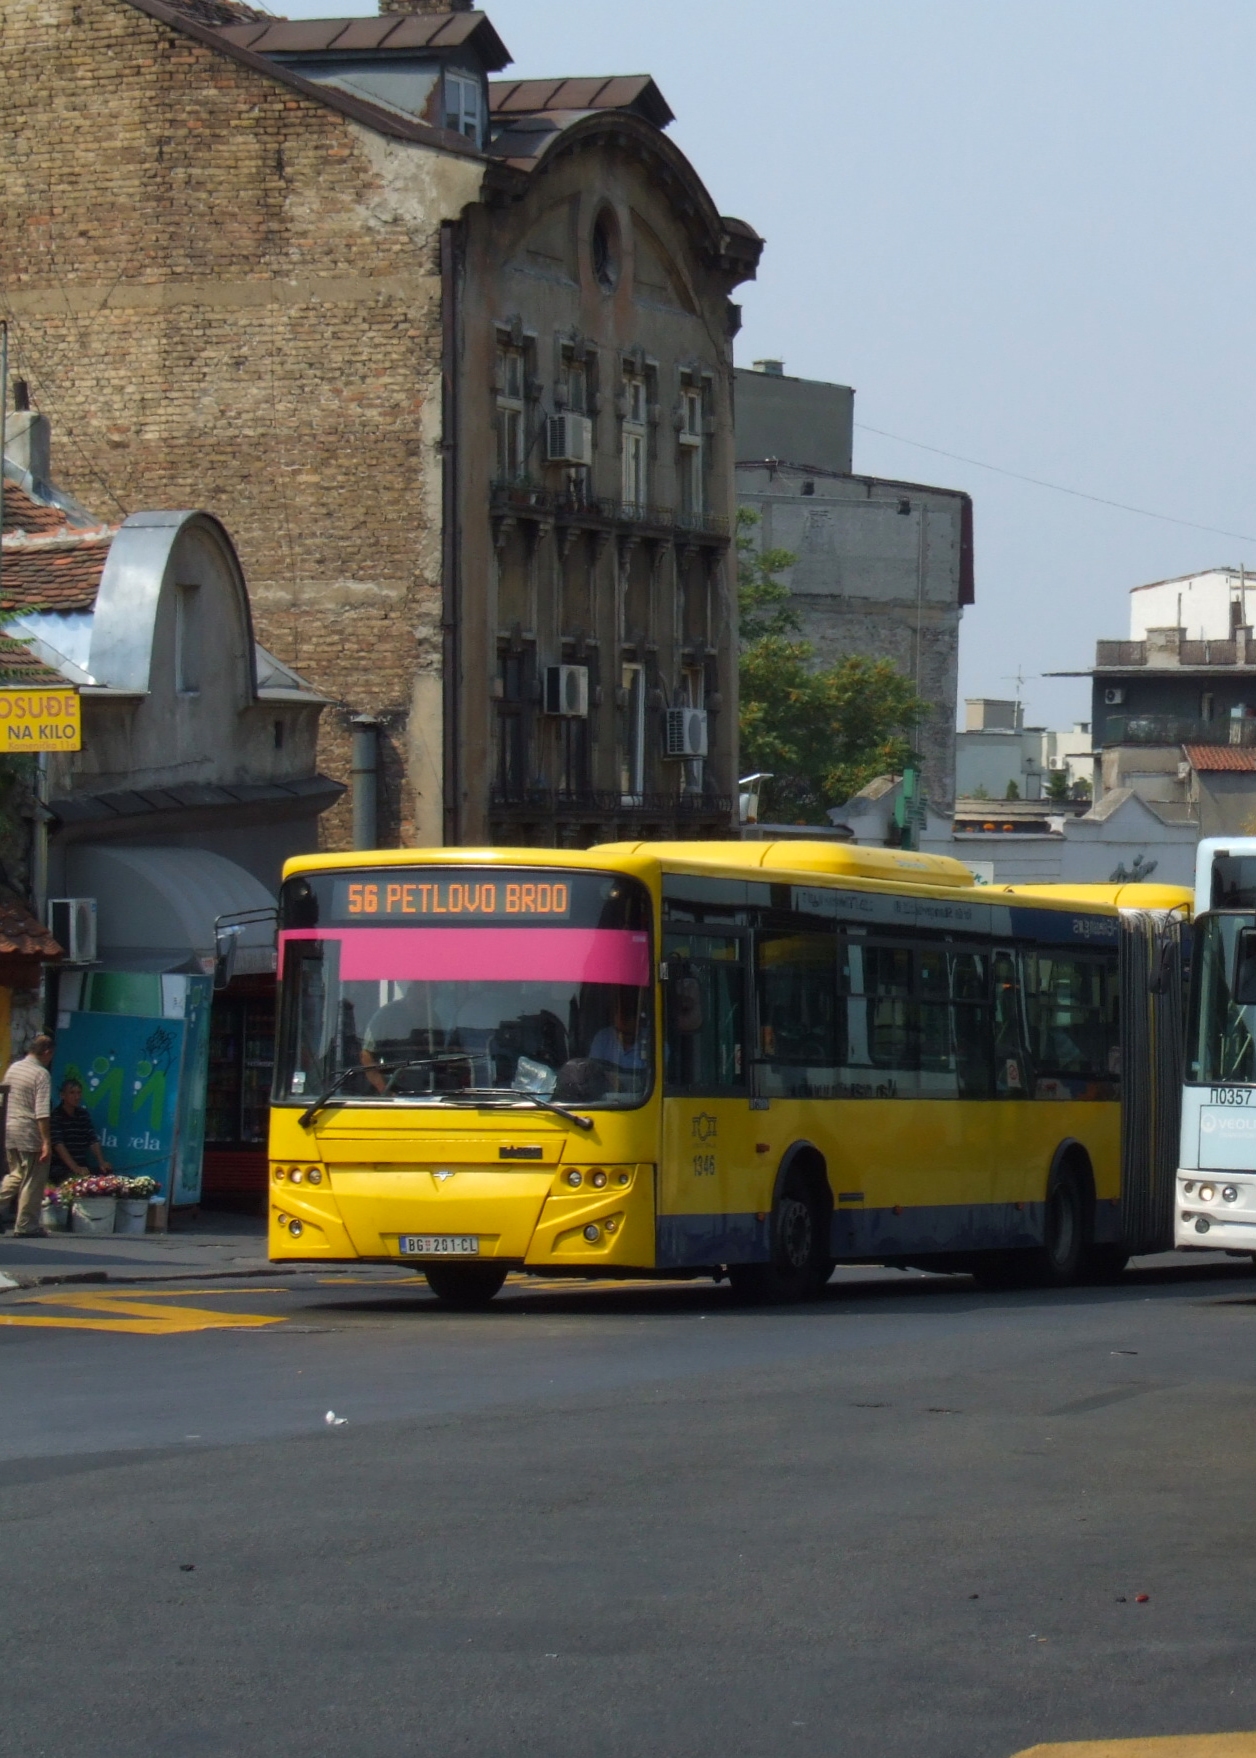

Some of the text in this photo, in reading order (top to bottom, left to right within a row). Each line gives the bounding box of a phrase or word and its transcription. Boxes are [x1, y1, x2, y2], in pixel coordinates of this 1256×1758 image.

[8, 724, 76, 740] NA KILO
[348, 884, 568, 913] 56 PETLOVO BRDO
[408, 1238, 424, 1252] BG
